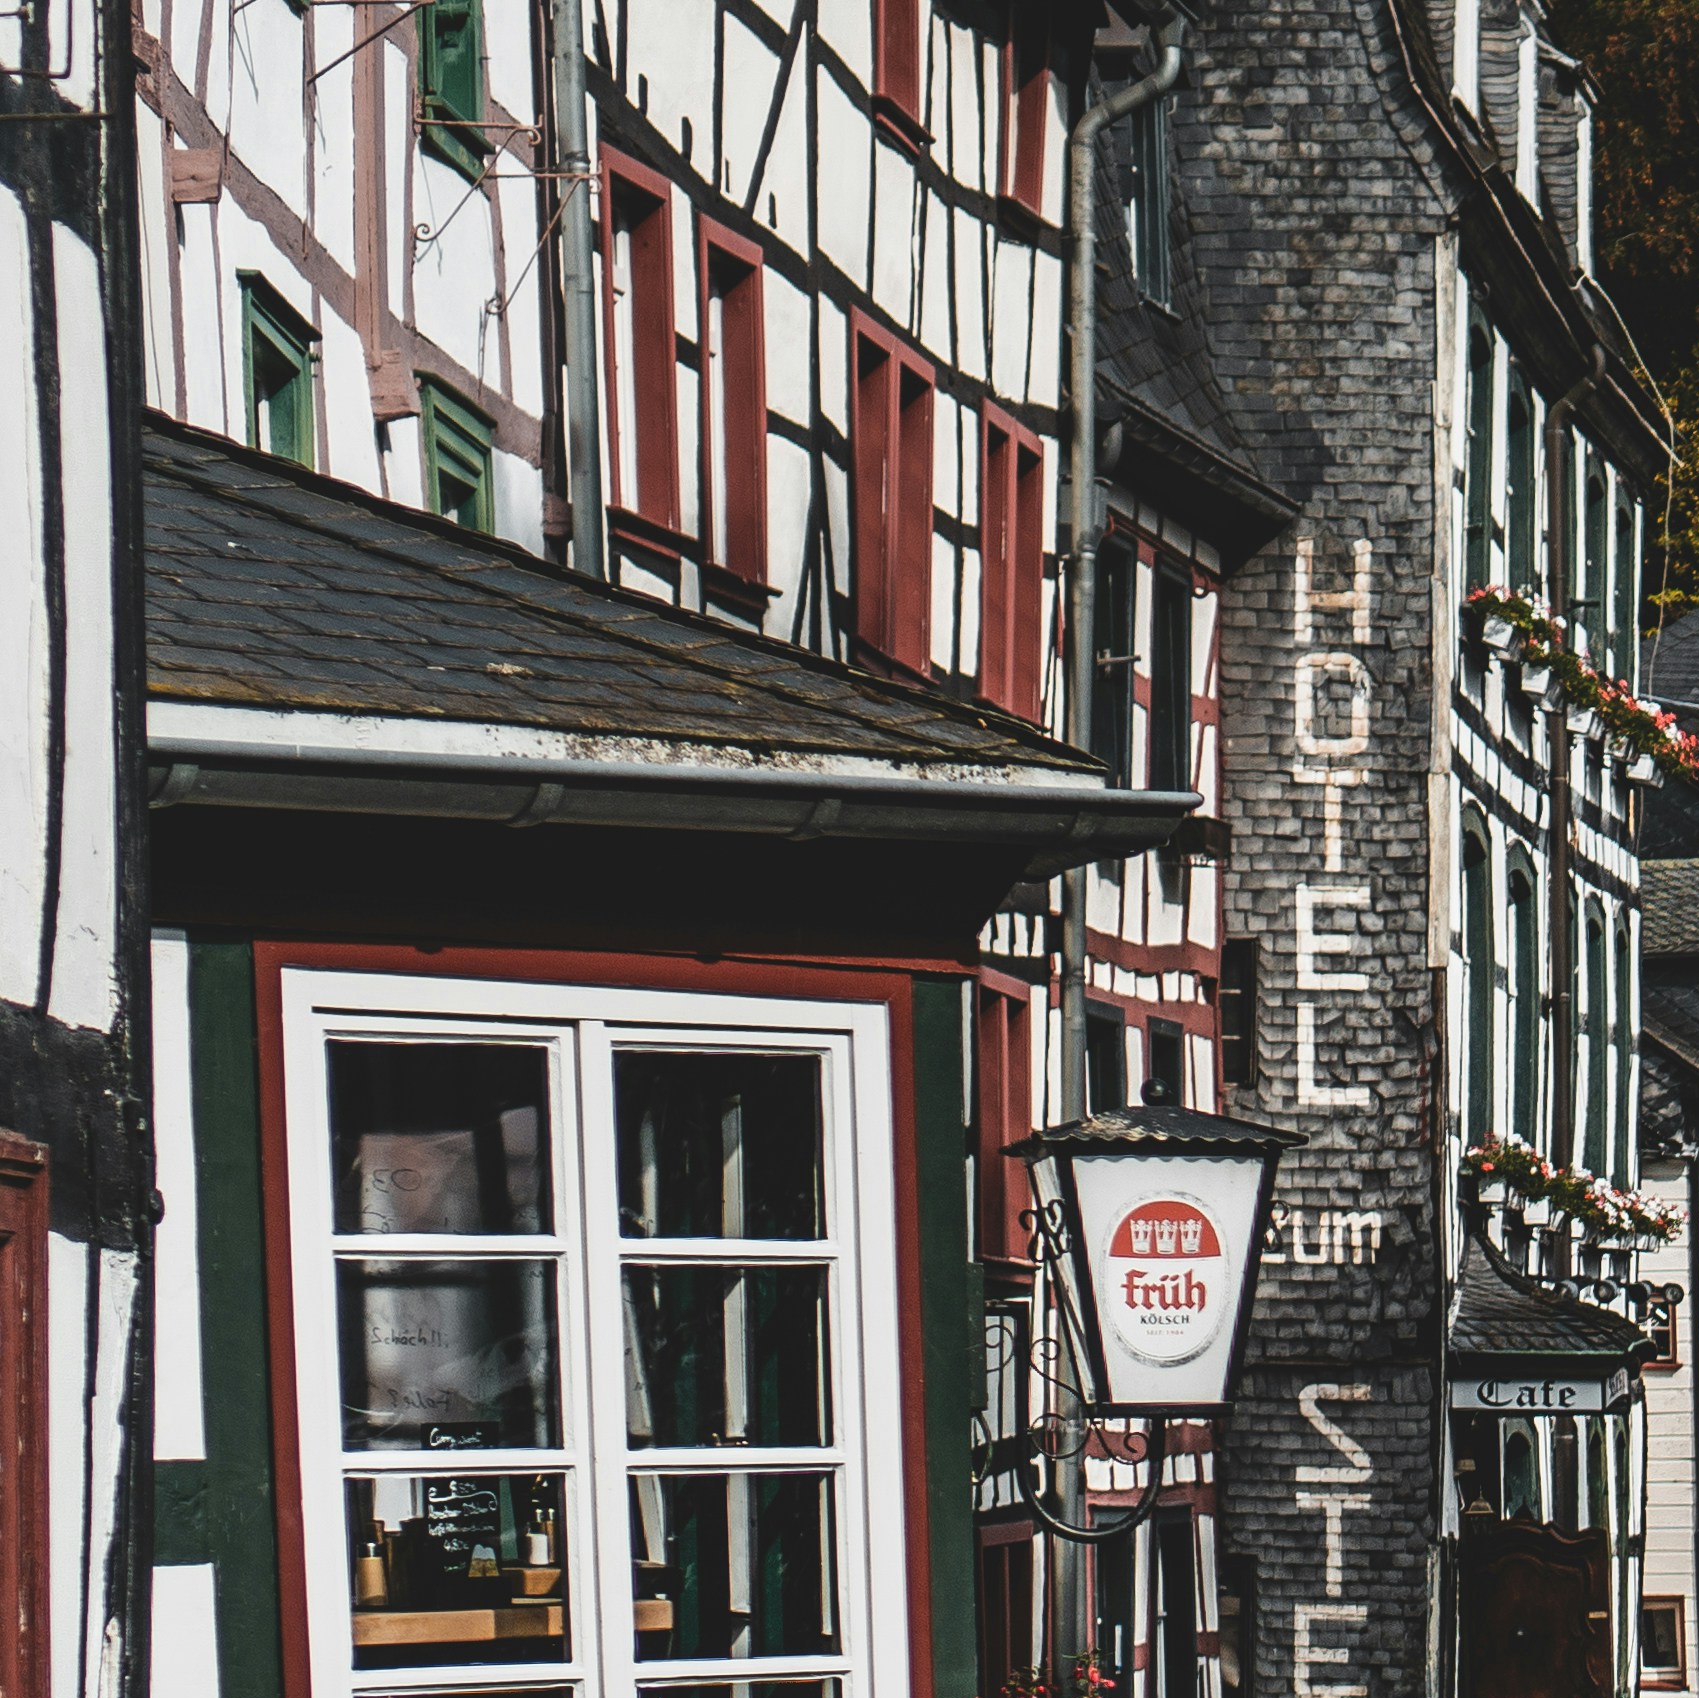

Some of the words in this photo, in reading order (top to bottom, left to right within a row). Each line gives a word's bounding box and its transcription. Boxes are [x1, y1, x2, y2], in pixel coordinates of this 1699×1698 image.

[1294, 536, 1371, 1106] HOTEL
[1120, 1268, 1206, 1312] früh
[1140, 1313, 1189, 1325] KÖLSCH
[1477, 1378, 1576, 1408] Cafe
